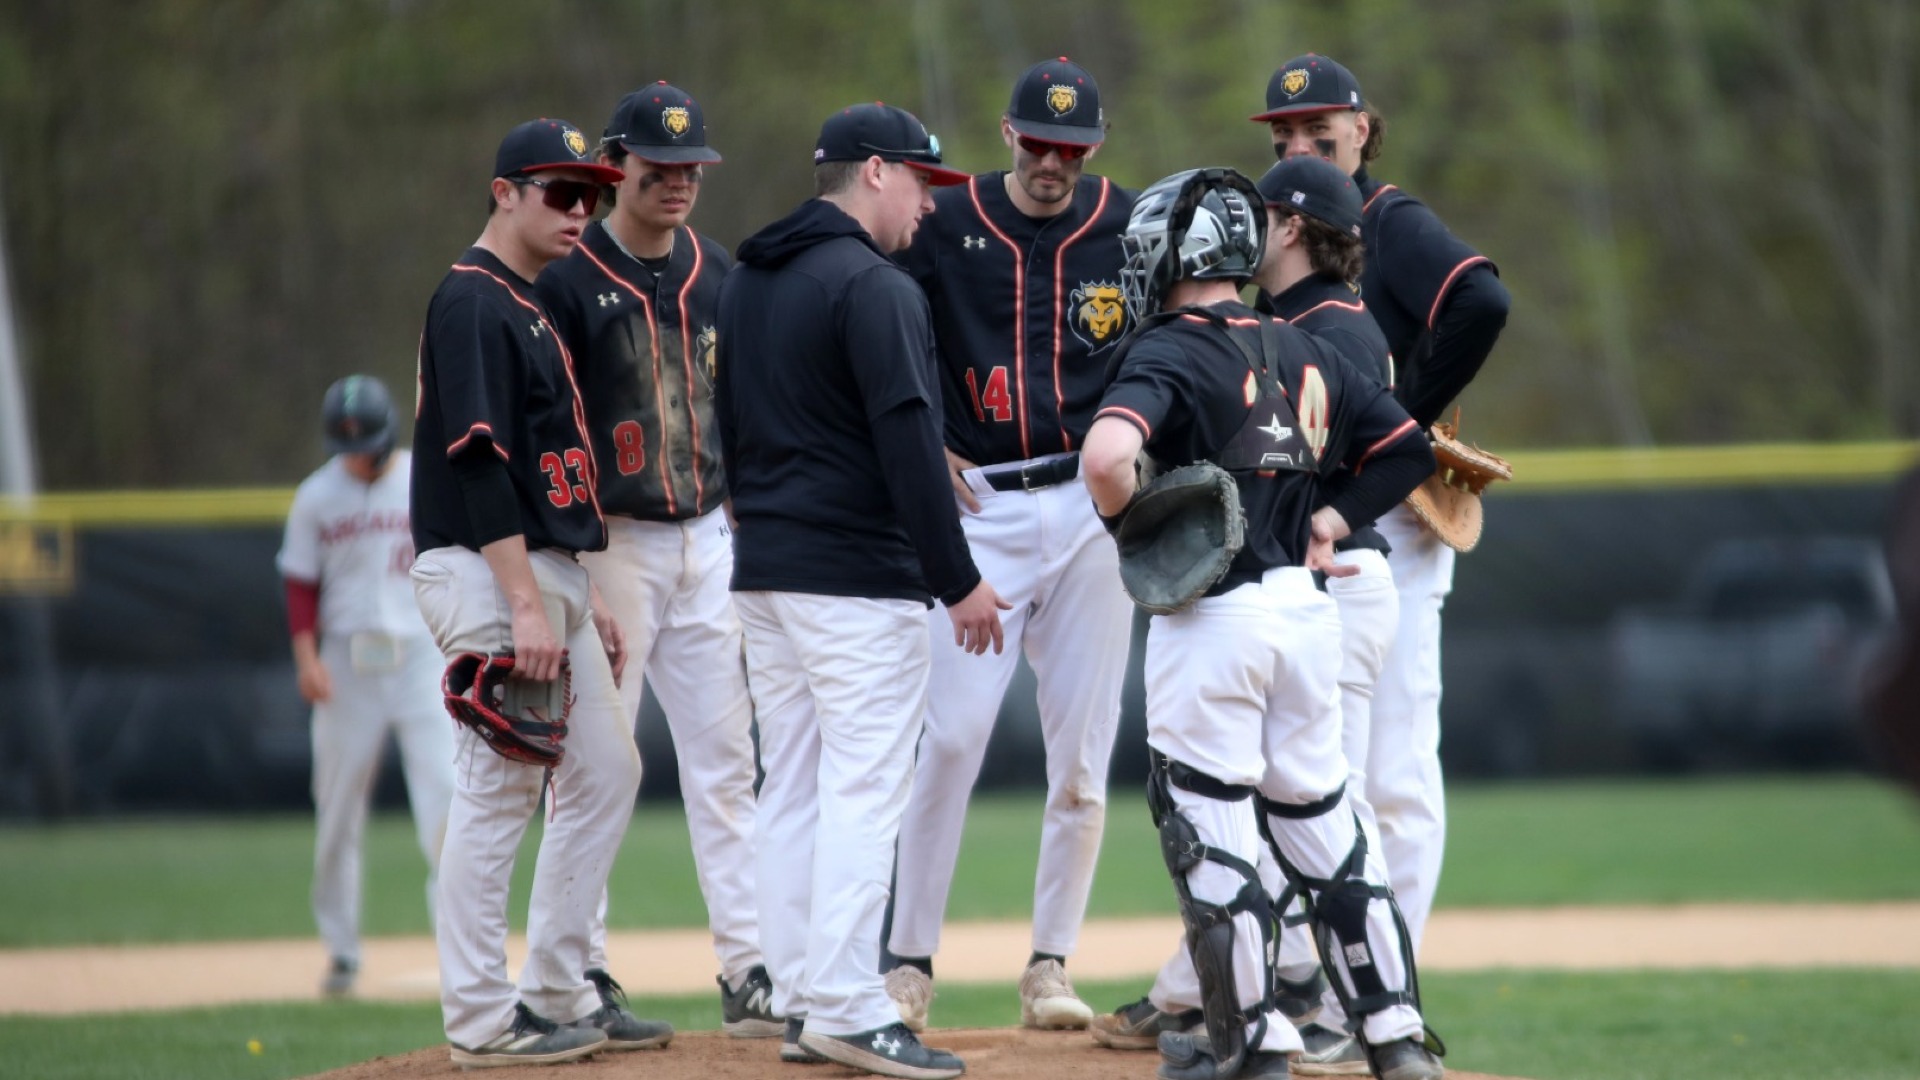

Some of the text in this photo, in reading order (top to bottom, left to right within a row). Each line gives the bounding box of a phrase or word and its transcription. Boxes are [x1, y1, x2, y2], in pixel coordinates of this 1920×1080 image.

[965, 366, 1012, 421] 14
[612, 420, 645, 476] 8
[540, 447, 587, 508] 33
